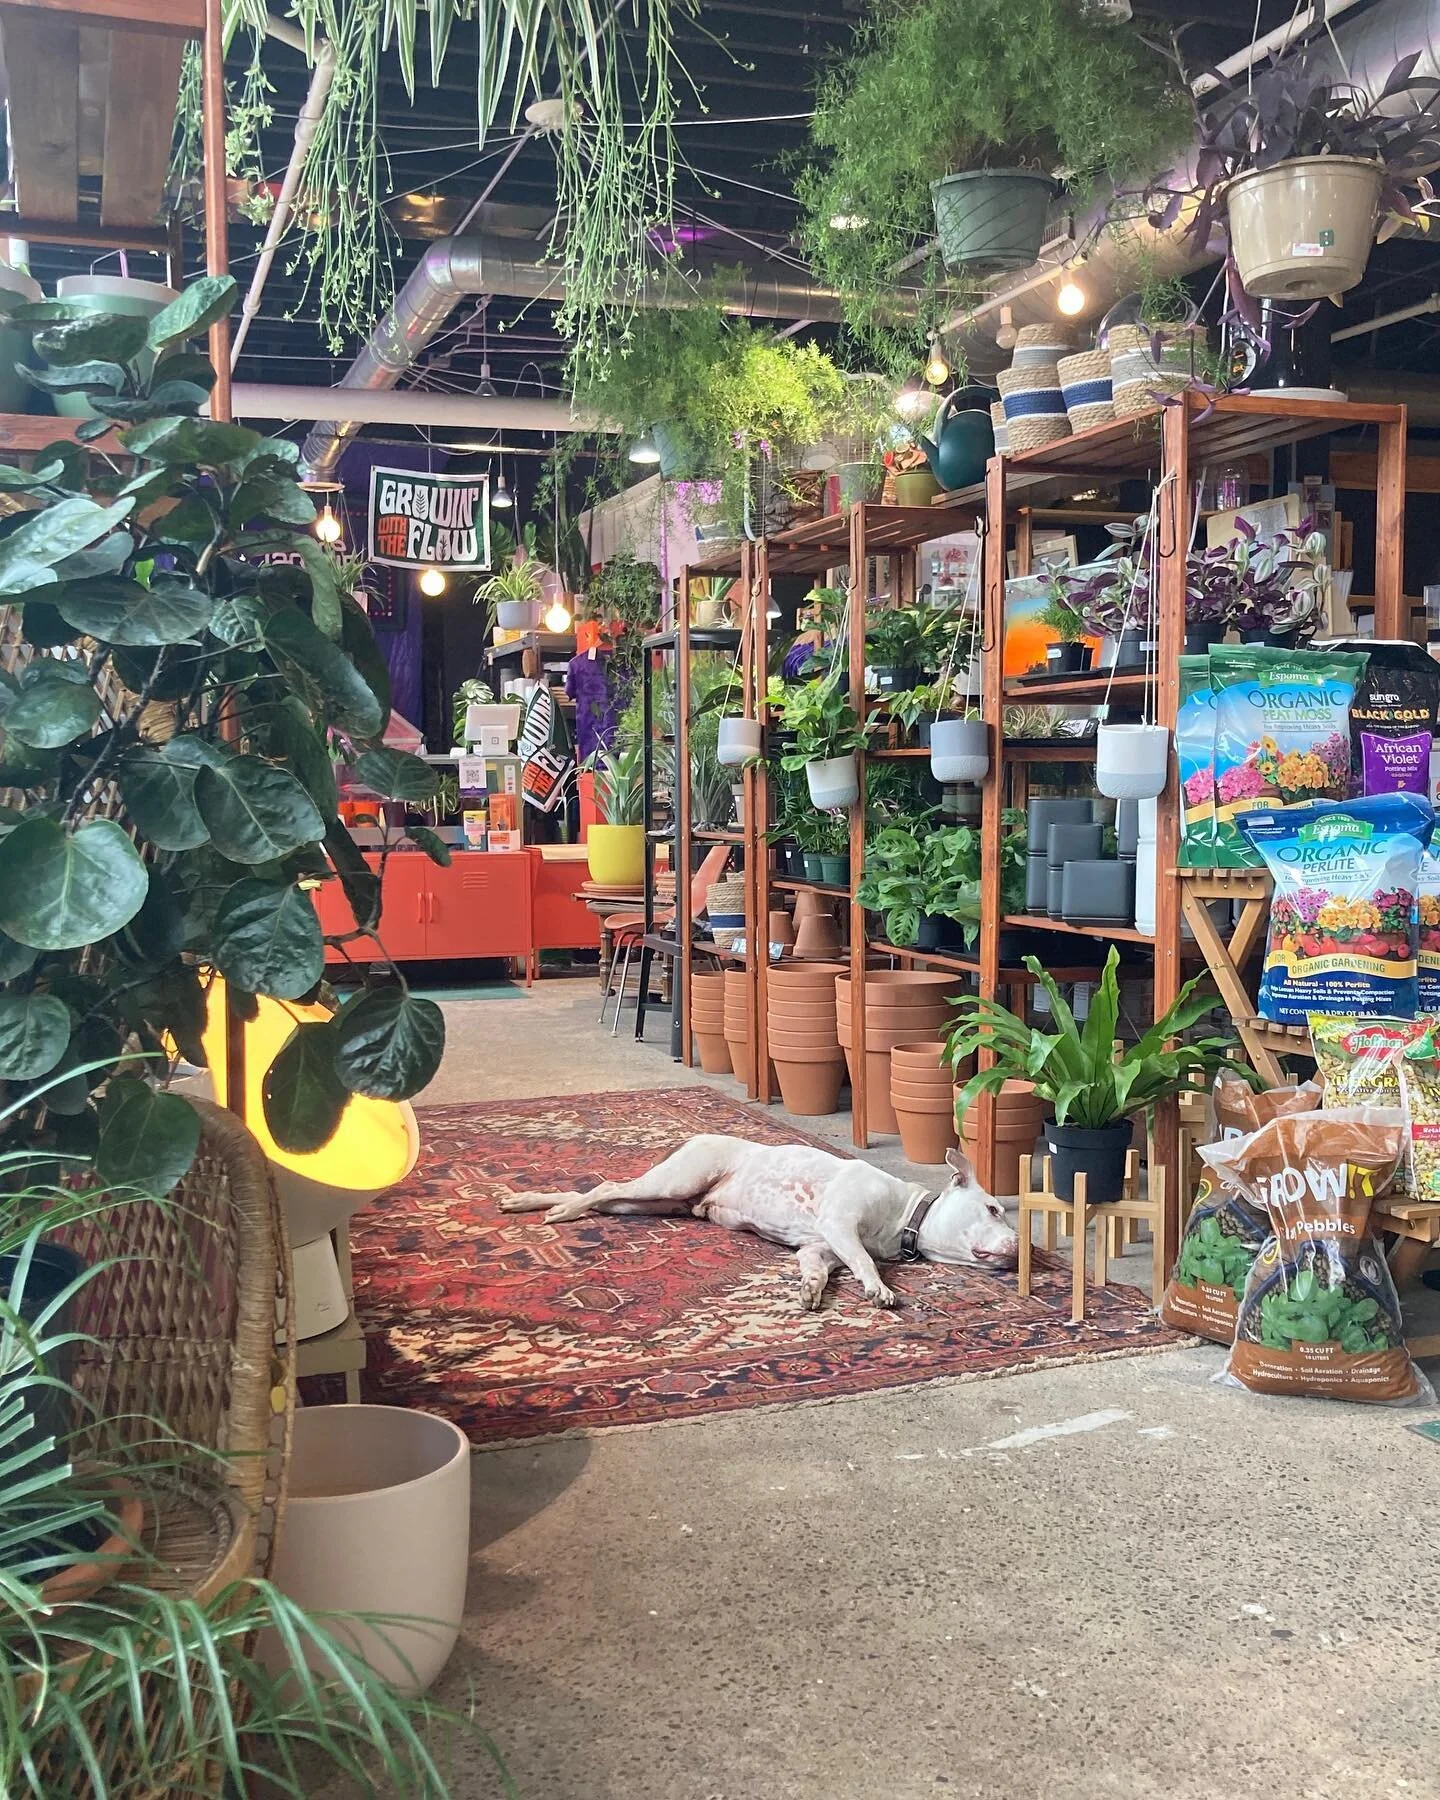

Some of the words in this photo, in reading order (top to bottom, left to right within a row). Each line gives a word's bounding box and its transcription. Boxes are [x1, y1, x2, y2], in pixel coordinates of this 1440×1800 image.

[380, 480, 479, 528] GROWIN'
[378, 516, 408, 534] WITH
[378, 535, 407, 557] THE
[407, 518, 478, 561] FLOW
[1269, 671, 1310, 681] Espoma
[1247, 690, 1345, 709] ORGANIC
[1264, 709, 1292, 721] PEAT
[1296, 708, 1332, 720] MOSS
[1351, 709, 1388, 720] BLACK
[1394, 709, 1429, 720] GOLD
[1375, 743, 1422, 753] African
[1382, 754, 1419, 764] Violet
[1312, 823, 1362, 836] Espoma
[1277, 840, 1388, 862] ORGANIC
[1303, 858, 1355, 874] PERLITE
[1292, 959, 1331, 974] ORGANIC
[1331, 958, 1385, 973] GARDENING
[1295, 987, 1312, 995] Heavy
[1318, 995, 1345, 1003] Drainage
[1350, 1033, 1403, 1054] Hoffman
[1296, 1218, 1356, 1236] Pebbles
[1252, 1368, 1293, 1381] Hydroculture
[1300, 1376, 1343, 1384] Hydroponics
[1351, 1376, 1390, 1384] Aquaponics
[1314, 1367, 1343, 1375] Aeration
[1351, 1366, 1382, 1375] Drainage
